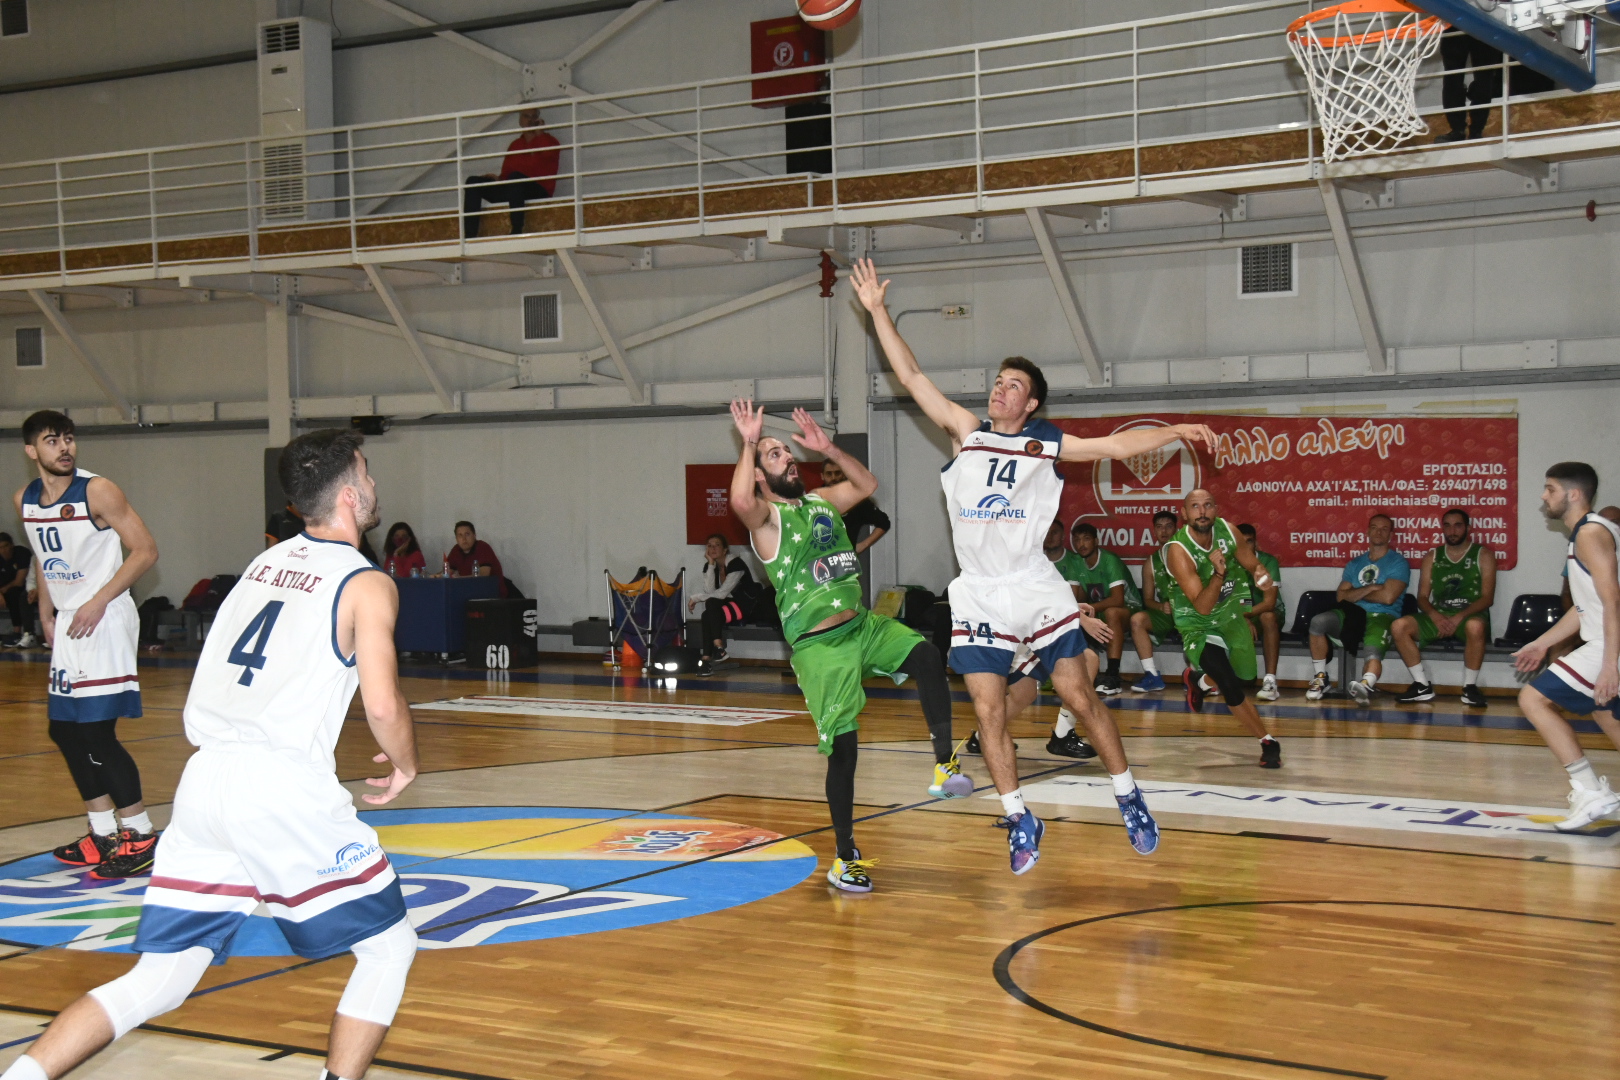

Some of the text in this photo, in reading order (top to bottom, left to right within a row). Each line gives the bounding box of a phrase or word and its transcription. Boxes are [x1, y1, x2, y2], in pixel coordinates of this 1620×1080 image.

[986, 457, 1018, 490] 14
[1422, 463, 1507, 476] ΕΡΓΟΣΤΑΣΙΟ:
[1236, 481, 1303, 493] ΔΑΦΝΟΥΛΑ
[1432, 479, 1507, 491] 2694071498
[1114, 505, 1151, 514] ΜΠΙΤΑΣ
[1352, 494, 1507, 508] miloiachaias@gmail.com
[36, 526, 63, 553] 10
[1096, 528, 1135, 546] ΥΛΟΙ
[1290, 532, 1355, 544] ΕΥΡΙΠΙΔΟΥ
[522, 609, 538, 638] 40
[960, 620, 996, 645] 14
[227, 599, 285, 687] 4
[485, 644, 510, 670] 60
[51, 666, 72, 694] 10
